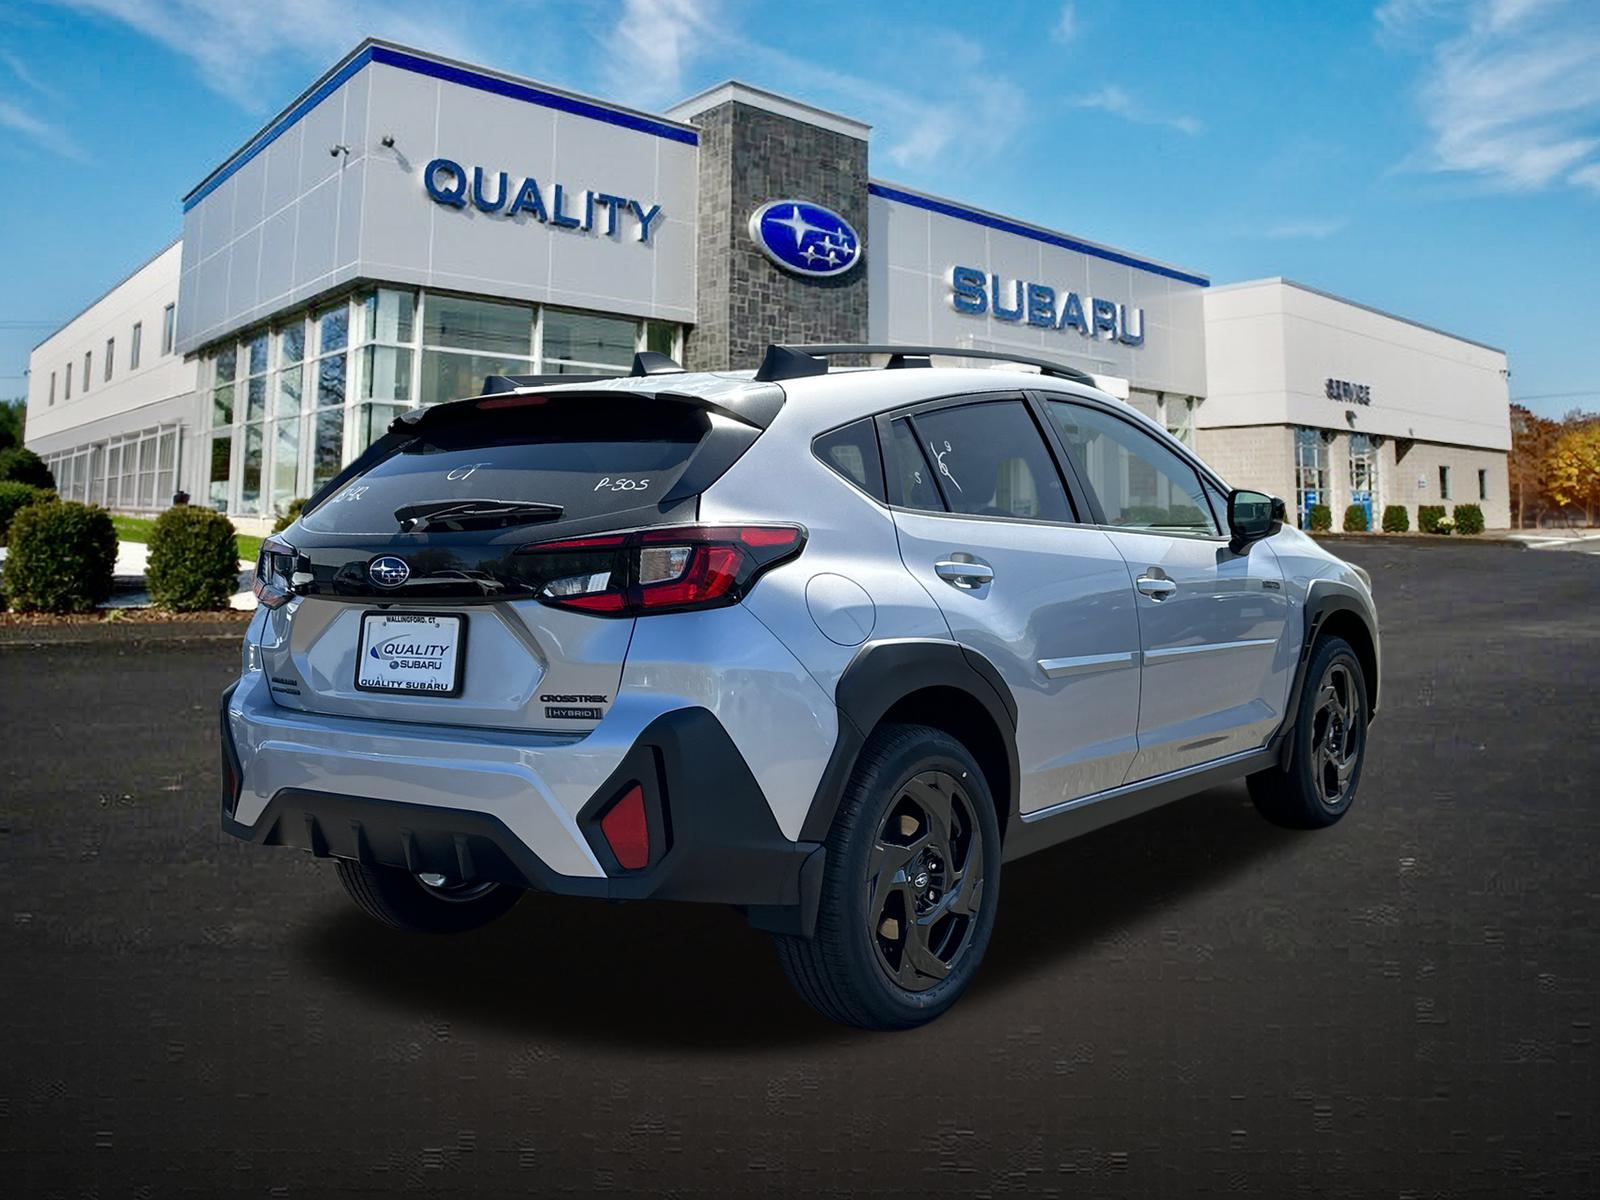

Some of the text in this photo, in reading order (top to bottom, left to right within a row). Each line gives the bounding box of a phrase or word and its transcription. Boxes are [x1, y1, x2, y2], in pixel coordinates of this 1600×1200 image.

[423, 158, 661, 242] QUALITY
[951, 265, 1144, 346] SUBARU
[1325, 378, 1370, 406] SERVICE
[384, 643, 450, 656] QUALITY
[400, 660, 442, 670] SUBARU
[360, 679, 448, 691] QUALITY SUBARU
[540, 694, 608, 703] CROSSTREK
[553, 709, 592, 717] HYBRID
